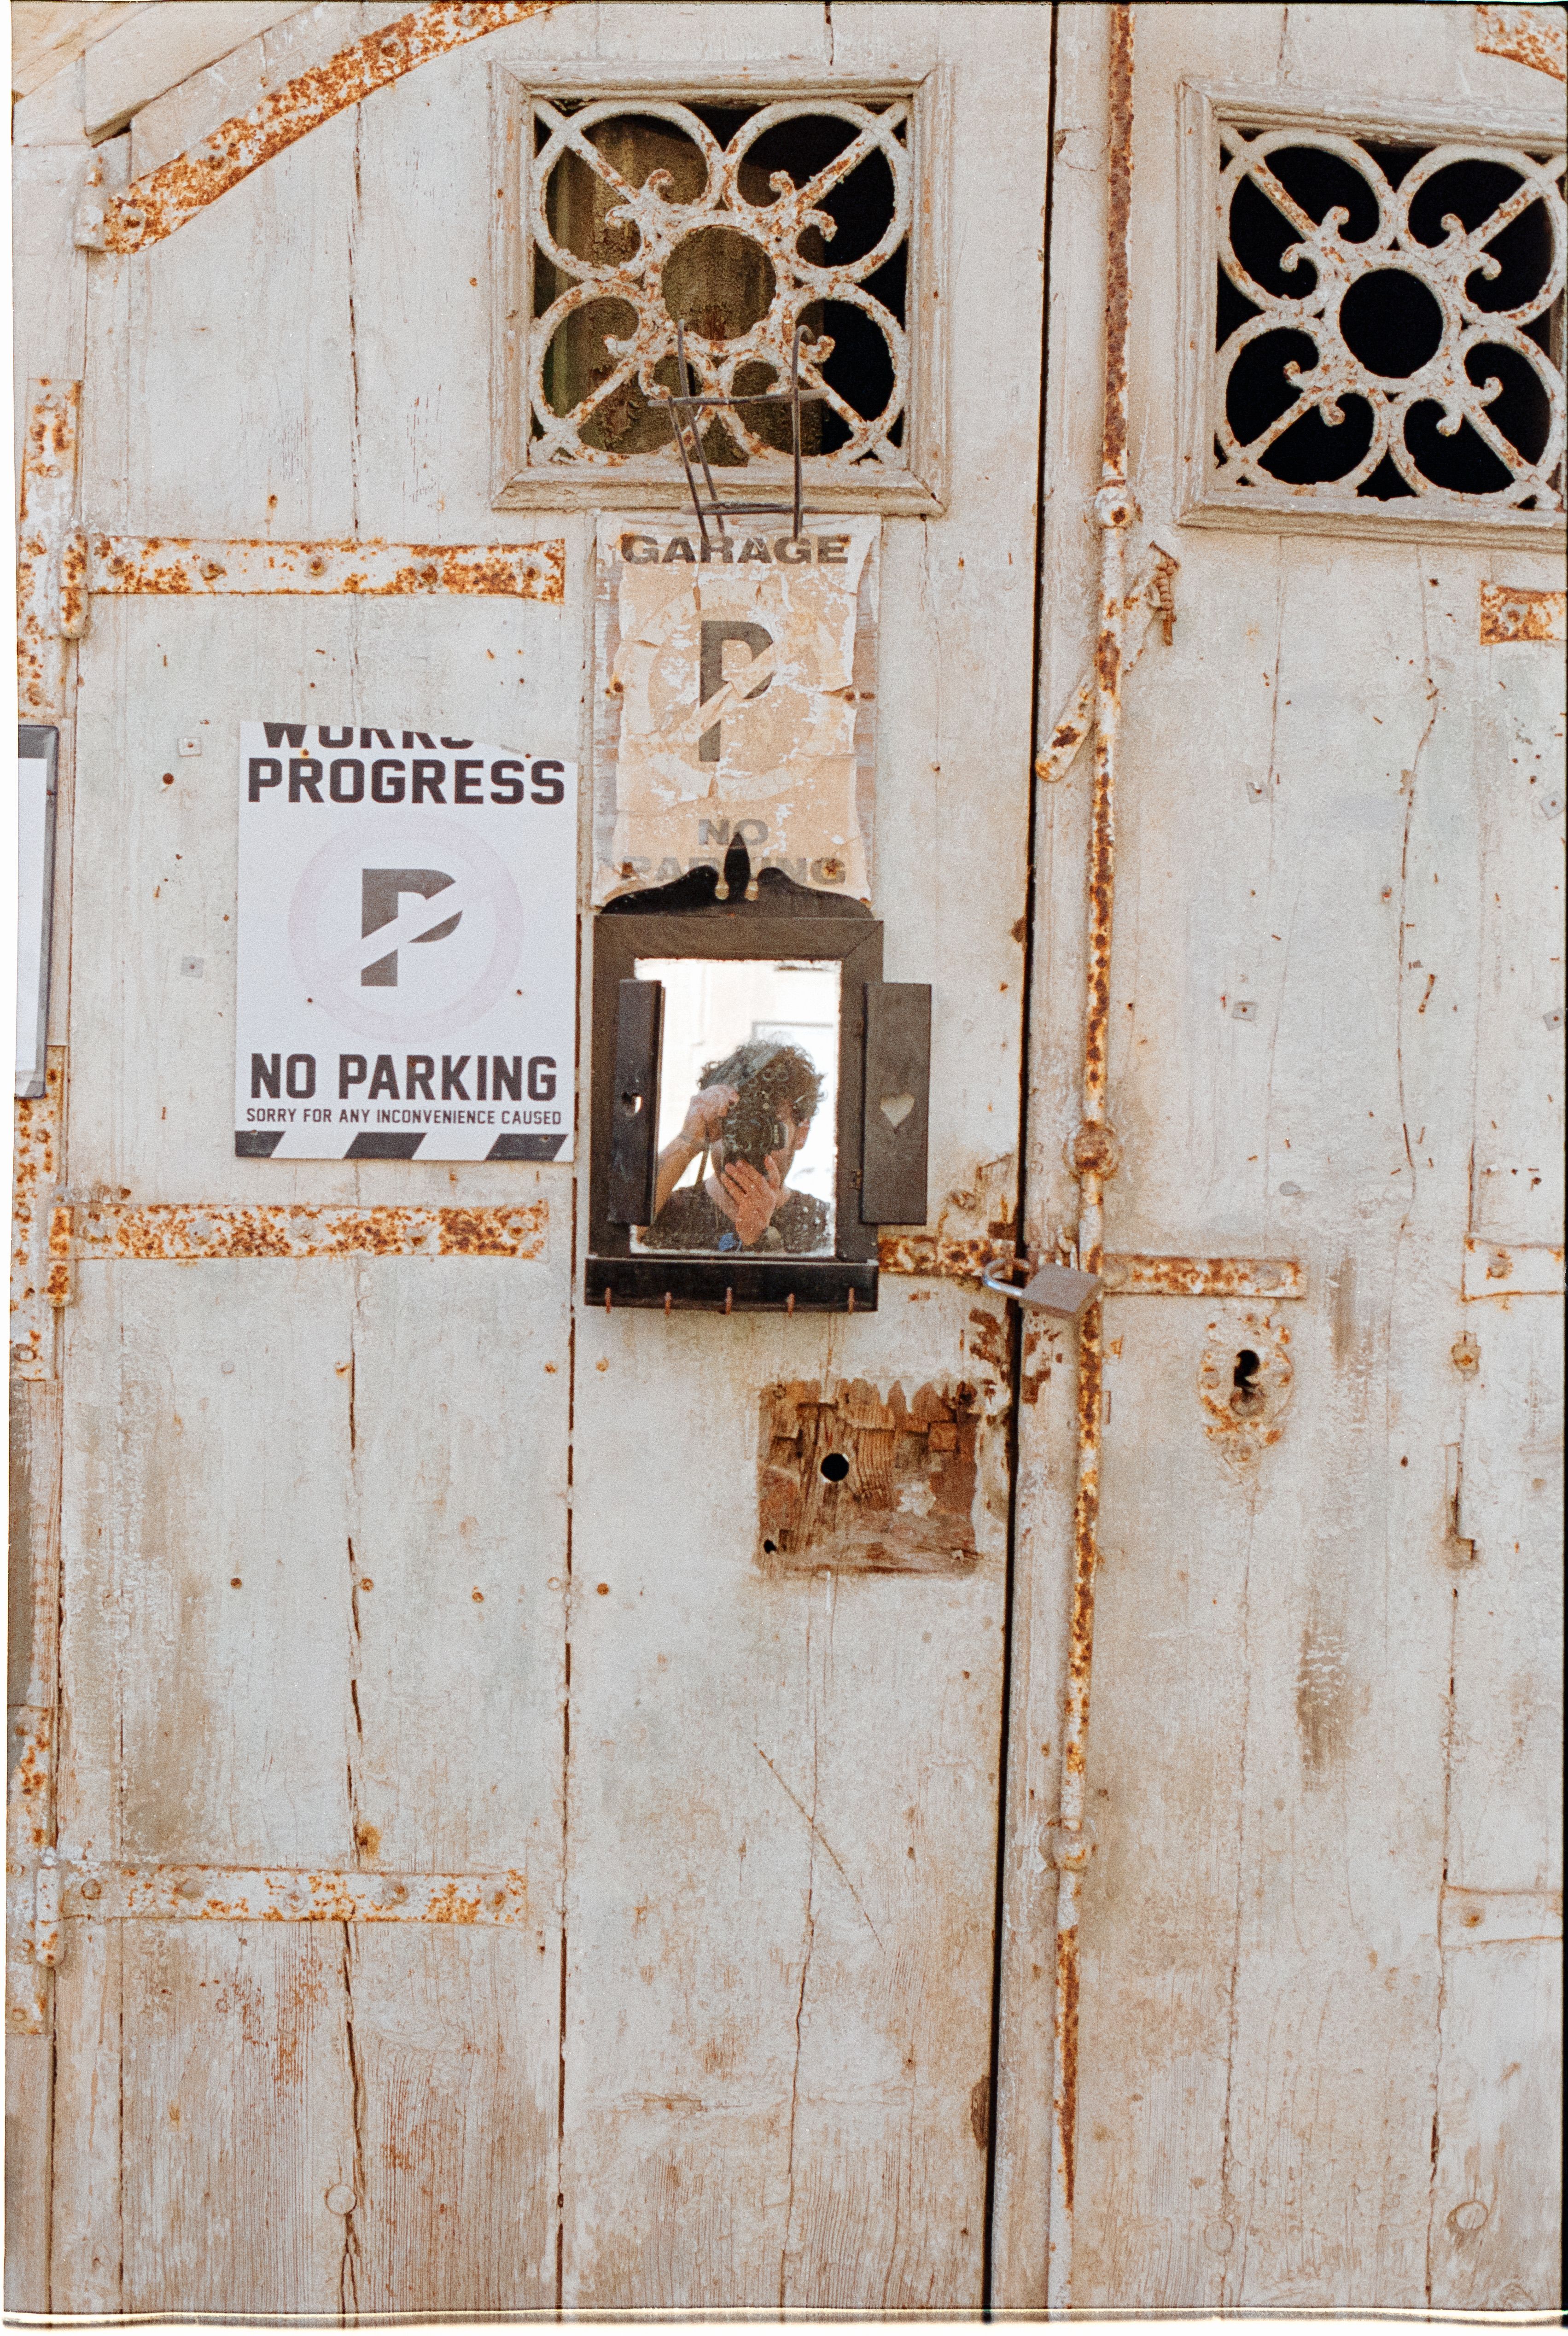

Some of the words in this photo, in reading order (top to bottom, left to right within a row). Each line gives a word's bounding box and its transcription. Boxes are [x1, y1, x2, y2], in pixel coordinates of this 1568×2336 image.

[621, 535, 849, 565] GARAGE
[248, 758, 564, 805] PROGRESS
[699, 818, 768, 845] NO
[251, 1053, 315, 1098] NO
[339, 1054, 556, 1101] PARKING
[247, 1108, 296, 1122] SORRY
[303, 1109, 332, 1122] FOR
[339, 1109, 370, 1122] ANY
[377, 1110, 494, 1124] INCONVENIENCE
[501, 1110, 561, 1125] CAUSED
